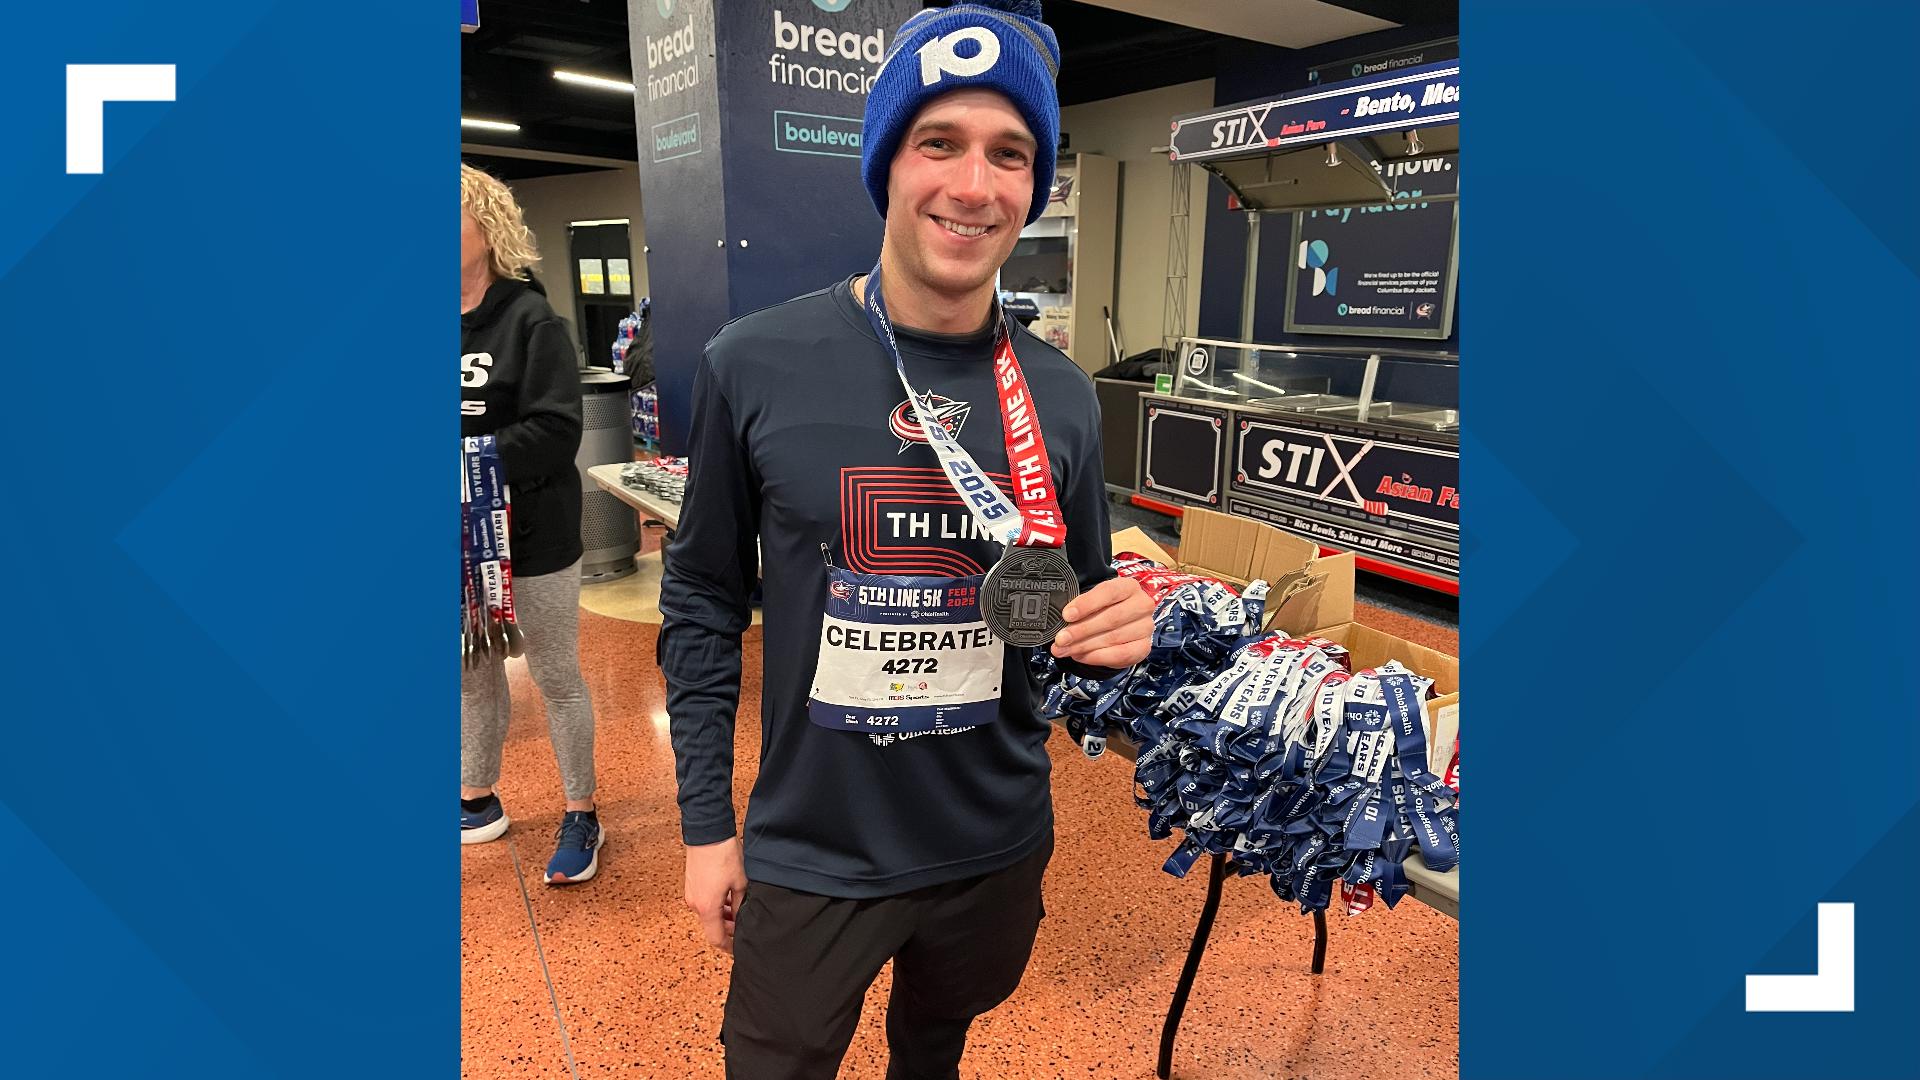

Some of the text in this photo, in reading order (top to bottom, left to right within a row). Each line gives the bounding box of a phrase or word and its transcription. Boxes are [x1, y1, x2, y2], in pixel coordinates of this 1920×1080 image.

[646, 14, 695, 69] bread
[774, 9, 885, 63] bread
[769, 53, 878, 95] financi
[1363, 53, 1424, 73] bread financial
[648, 55, 699, 102] financial
[1354, 92, 1416, 117] Bento,
[656, 124, 697, 151] boulevard
[1211, 102, 1280, 148] STIX
[1348, 306, 1405, 315] bread financial
[1006, 388, 1036, 454] LINE
[1258, 433, 1389, 516] STIX
[1376, 475, 1433, 504] Asian
[948, 460, 1010, 520] 2025
[495, 513, 505, 543] YEARS
[886, 512, 930, 538] TH
[940, 513, 1000, 541] LIN
[1293, 519, 1403, 554] Rice Bowls, Sake and More
[858, 585, 943, 608] 5TH LINE 5K
[947, 588, 967, 597] FEB
[1025, 580, 1047, 591] LINE
[946, 598, 976, 607] 2025
[1008, 593, 1042, 619] 10
[826, 625, 994, 652] CELEBRATE!
[881, 657, 938, 675] 4272
[1203, 672, 1238, 705] YEARS
[1256, 667, 1281, 702] YEARS
[1322, 691, 1335, 705] 10
[1354, 684, 1368, 698] 10
[1229, 684, 1256, 720] YEARS
[1393, 687, 1414, 736] OhioHealth
[866, 715, 899, 726] 4272
[1365, 805, 1379, 821] 10
[1415, 797, 1440, 848] OhioHealth
